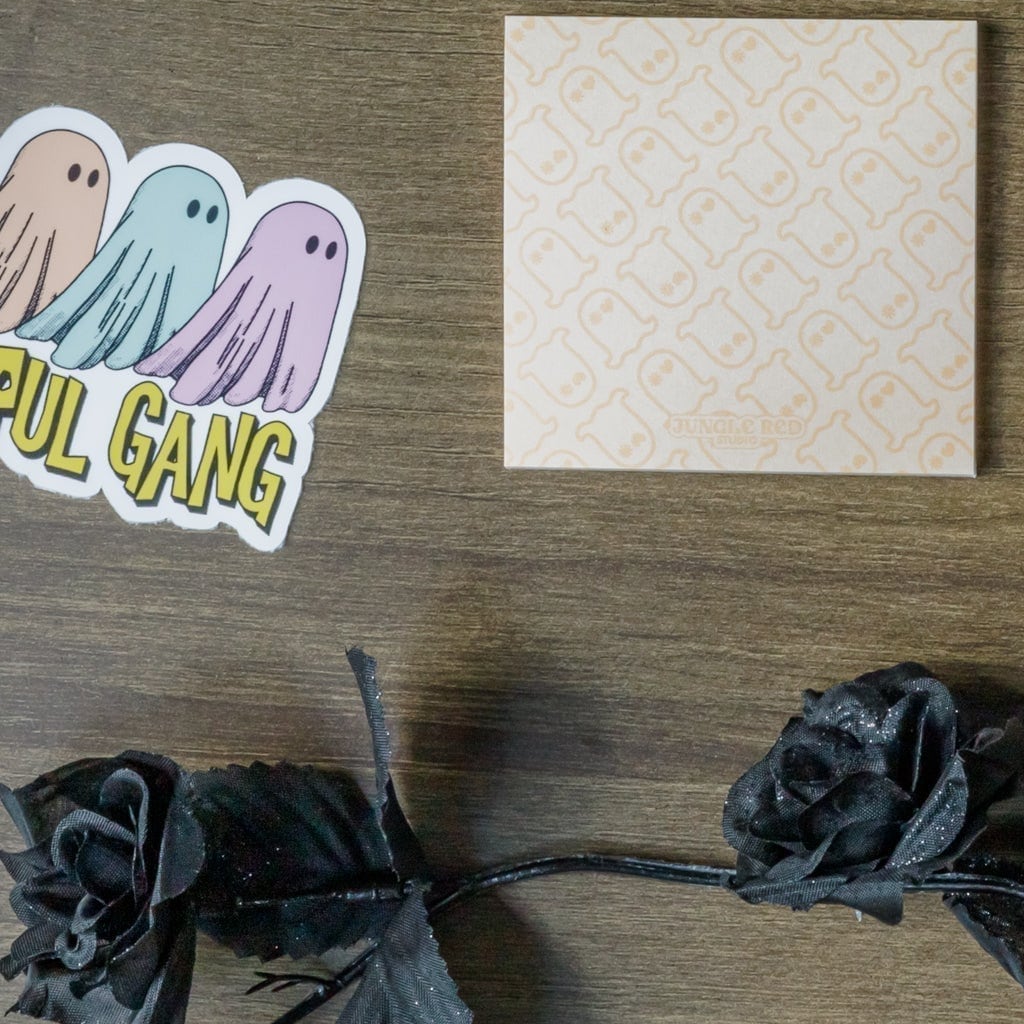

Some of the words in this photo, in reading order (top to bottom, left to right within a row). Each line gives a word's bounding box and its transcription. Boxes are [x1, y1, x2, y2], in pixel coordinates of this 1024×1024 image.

[107, 380, 297, 536] GANG
[672, 418, 754, 435] JUNGLE
[761, 419, 802, 435] RED
